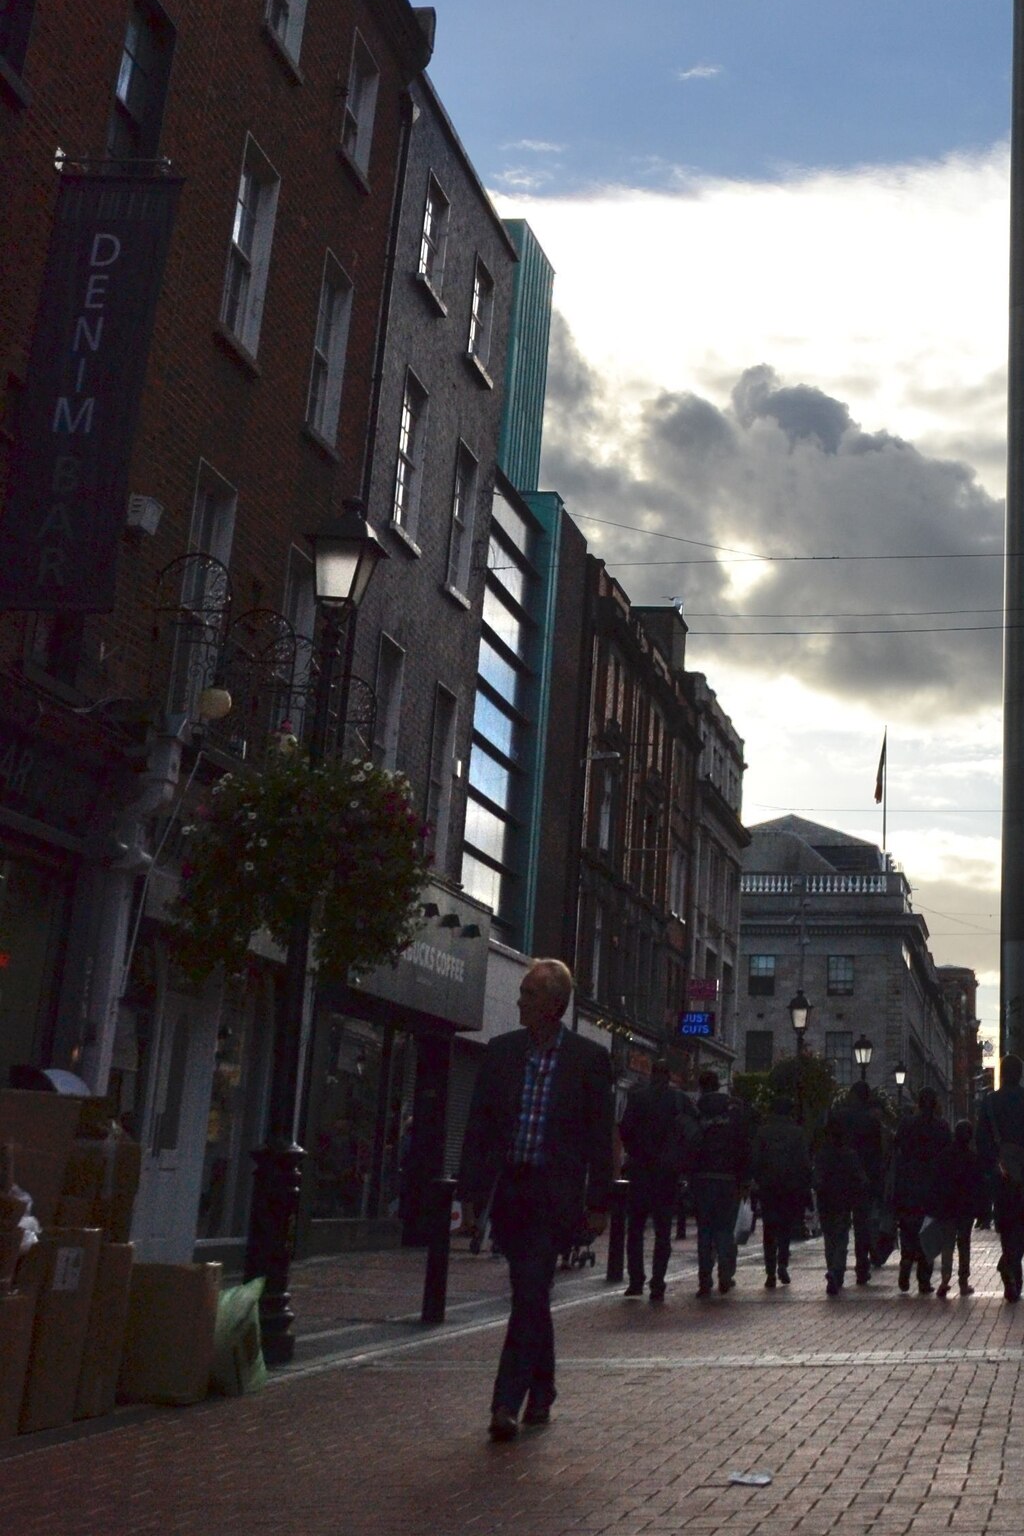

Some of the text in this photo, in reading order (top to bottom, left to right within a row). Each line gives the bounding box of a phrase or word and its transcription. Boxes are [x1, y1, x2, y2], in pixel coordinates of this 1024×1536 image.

[37, 232, 121, 588] DENIM BAR
[436, 949, 465, 983] COFFEE
[682, 1024, 710, 1034] CUTS
[683, 1013, 710, 1023] JUST
